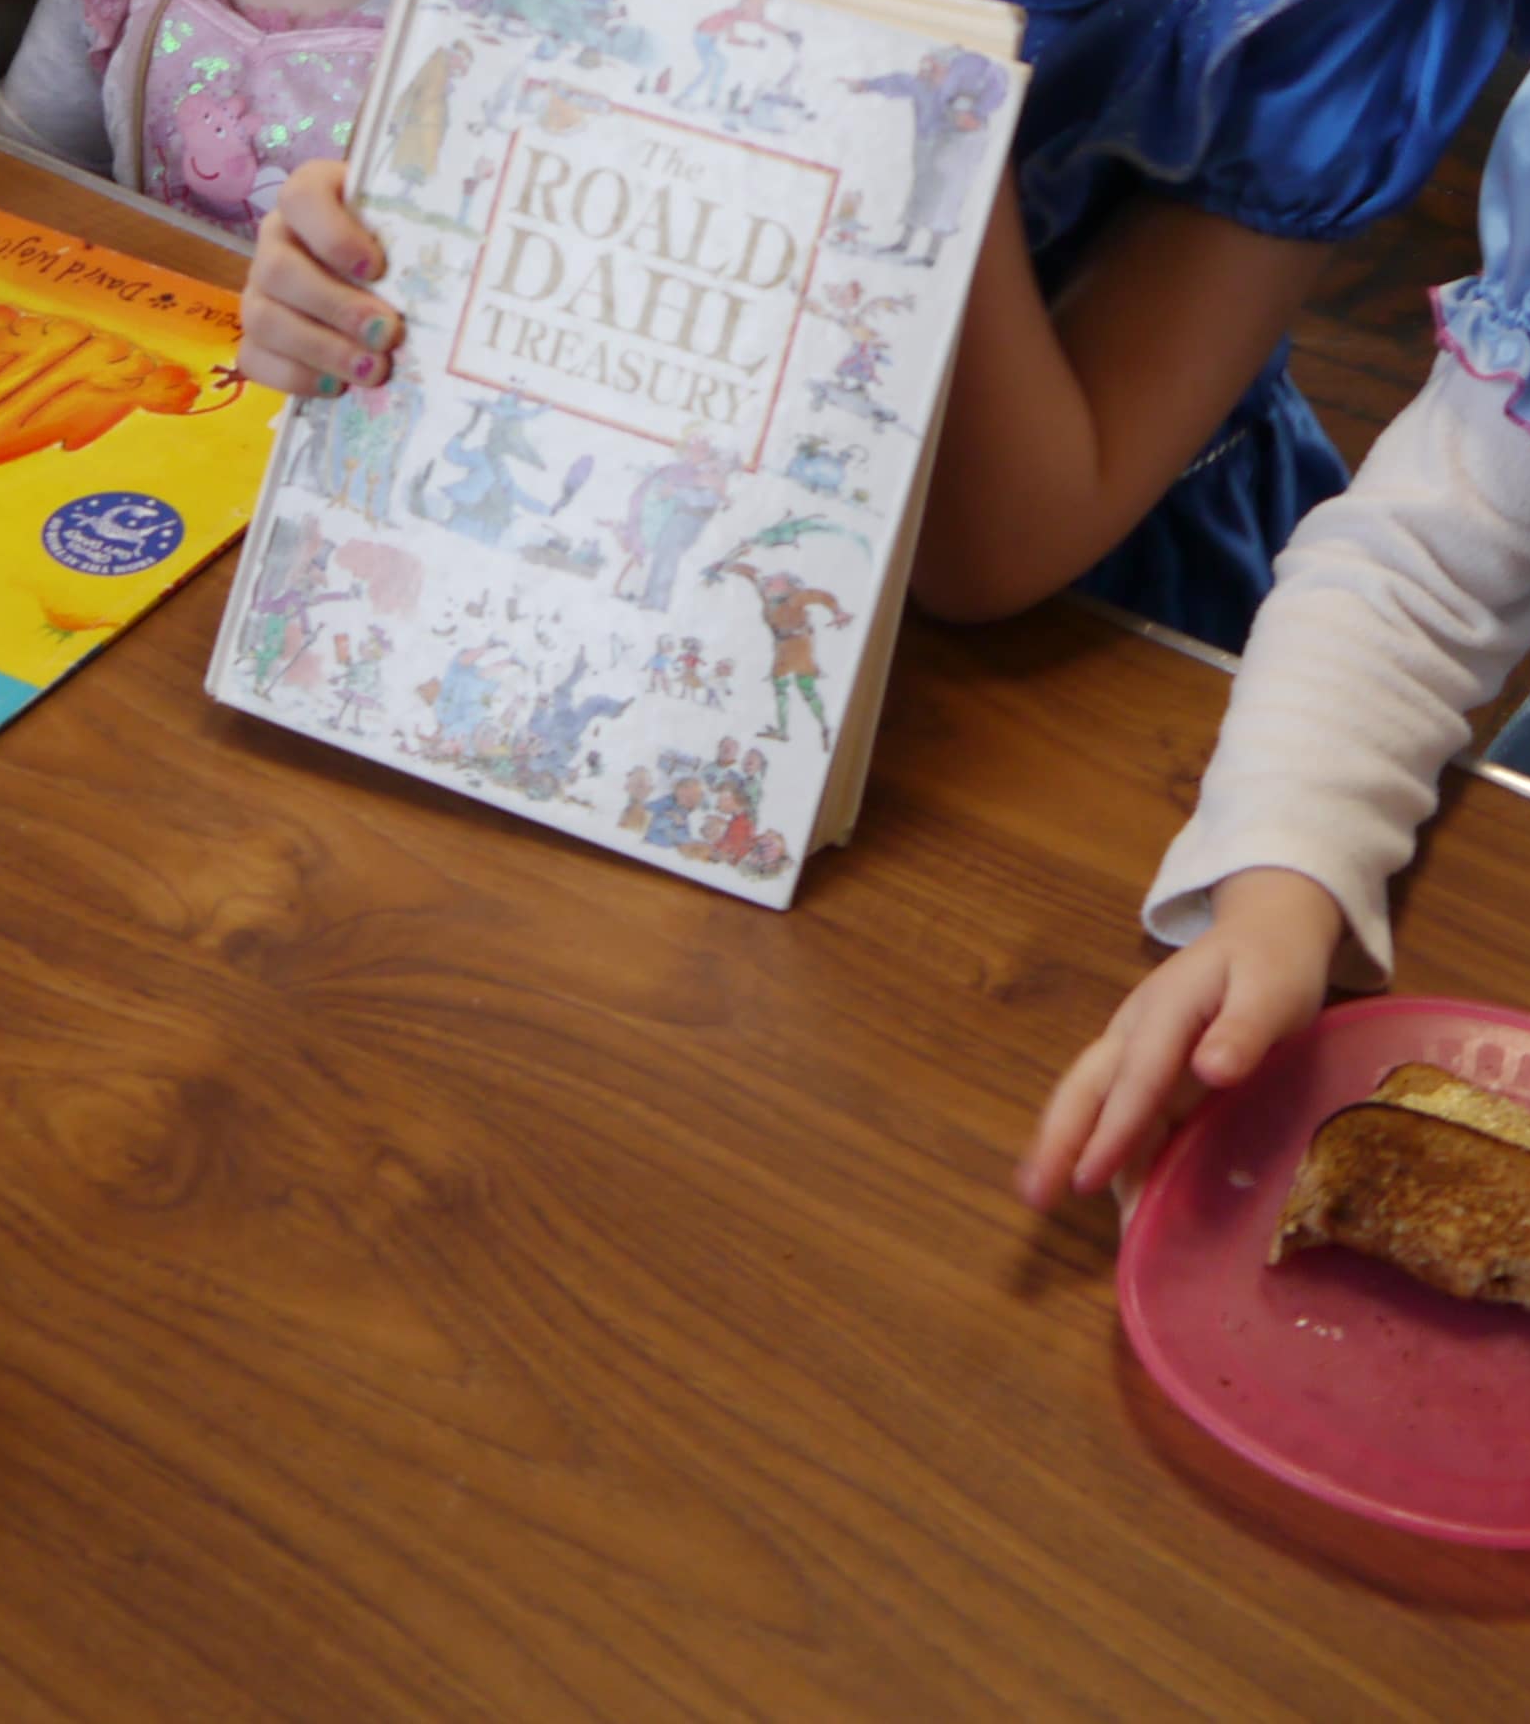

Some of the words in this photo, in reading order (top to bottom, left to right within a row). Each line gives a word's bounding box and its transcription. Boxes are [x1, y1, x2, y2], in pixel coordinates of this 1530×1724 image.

[509, 145, 799, 292] ROALD
[641, 139, 704, 180] The
[53, 260, 152, 302] David
[487, 224, 768, 378] DAHL
[480, 303, 760, 426] TREASURY
